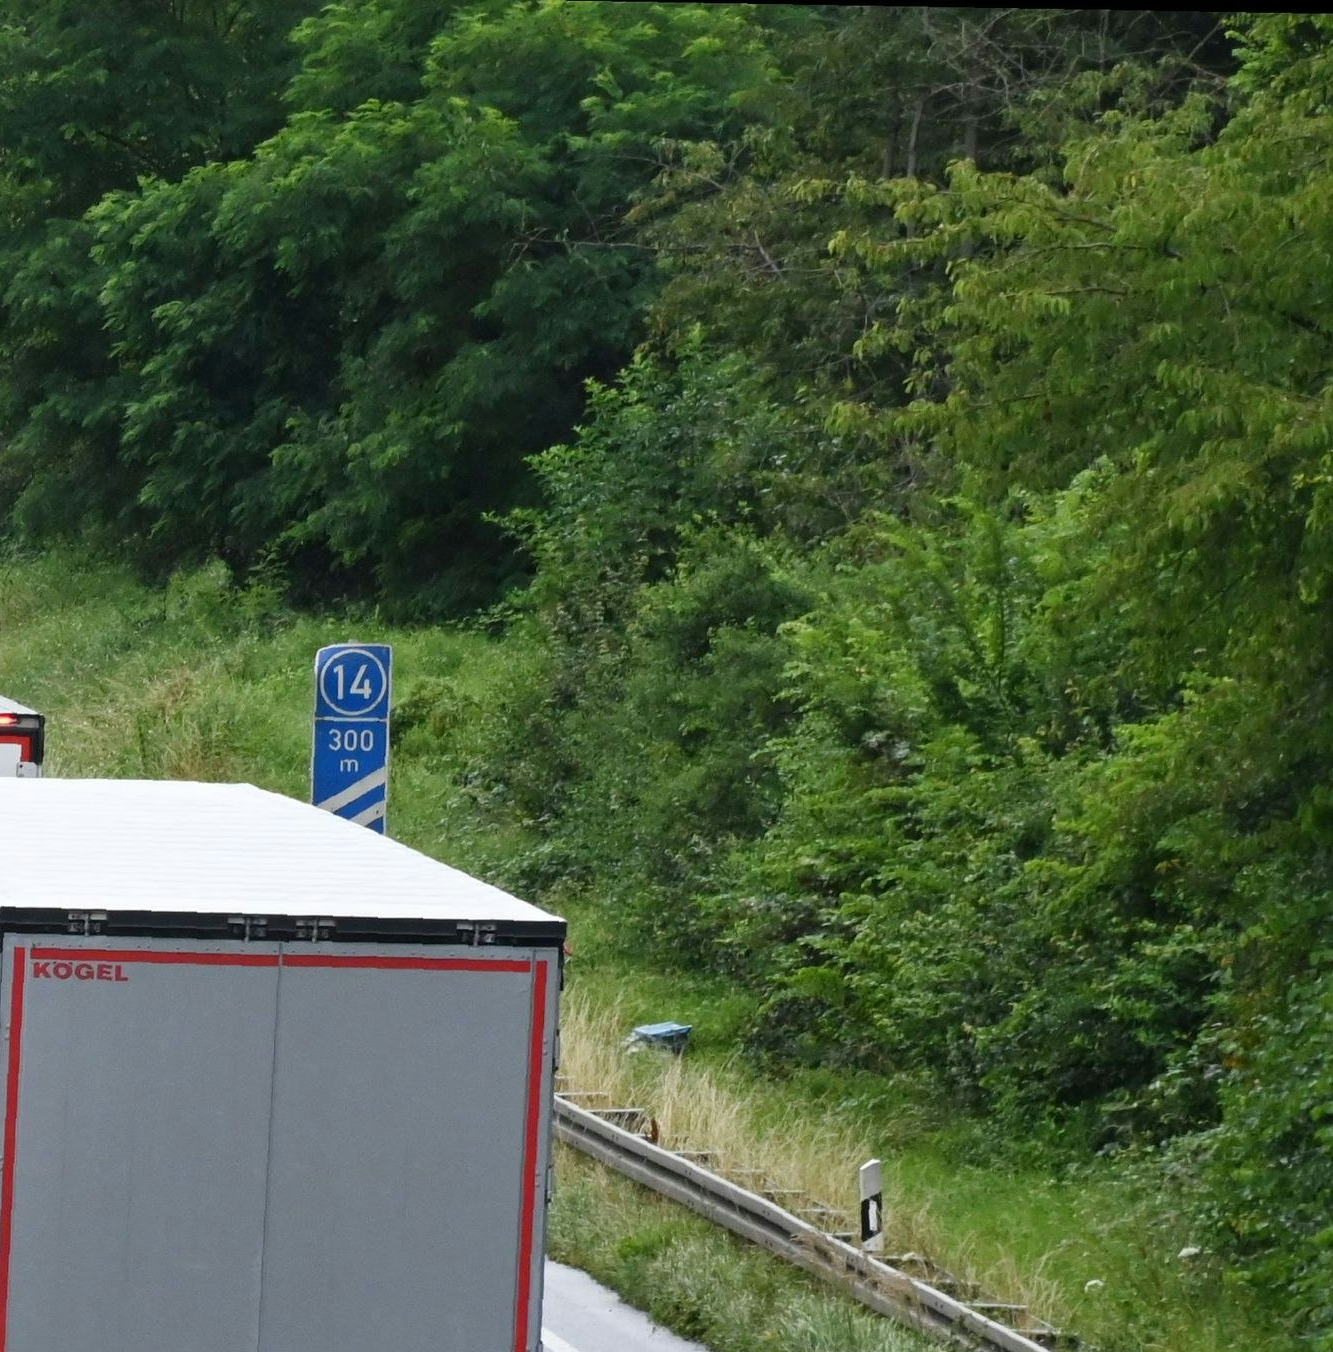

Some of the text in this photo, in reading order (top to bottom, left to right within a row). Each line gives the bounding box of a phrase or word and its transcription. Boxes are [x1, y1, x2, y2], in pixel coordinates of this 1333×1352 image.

[333, 664, 372, 700] 14
[328, 728, 373, 752] 300
[340, 758, 359, 773] m
[33, 961, 129, 982] KÖGEL
